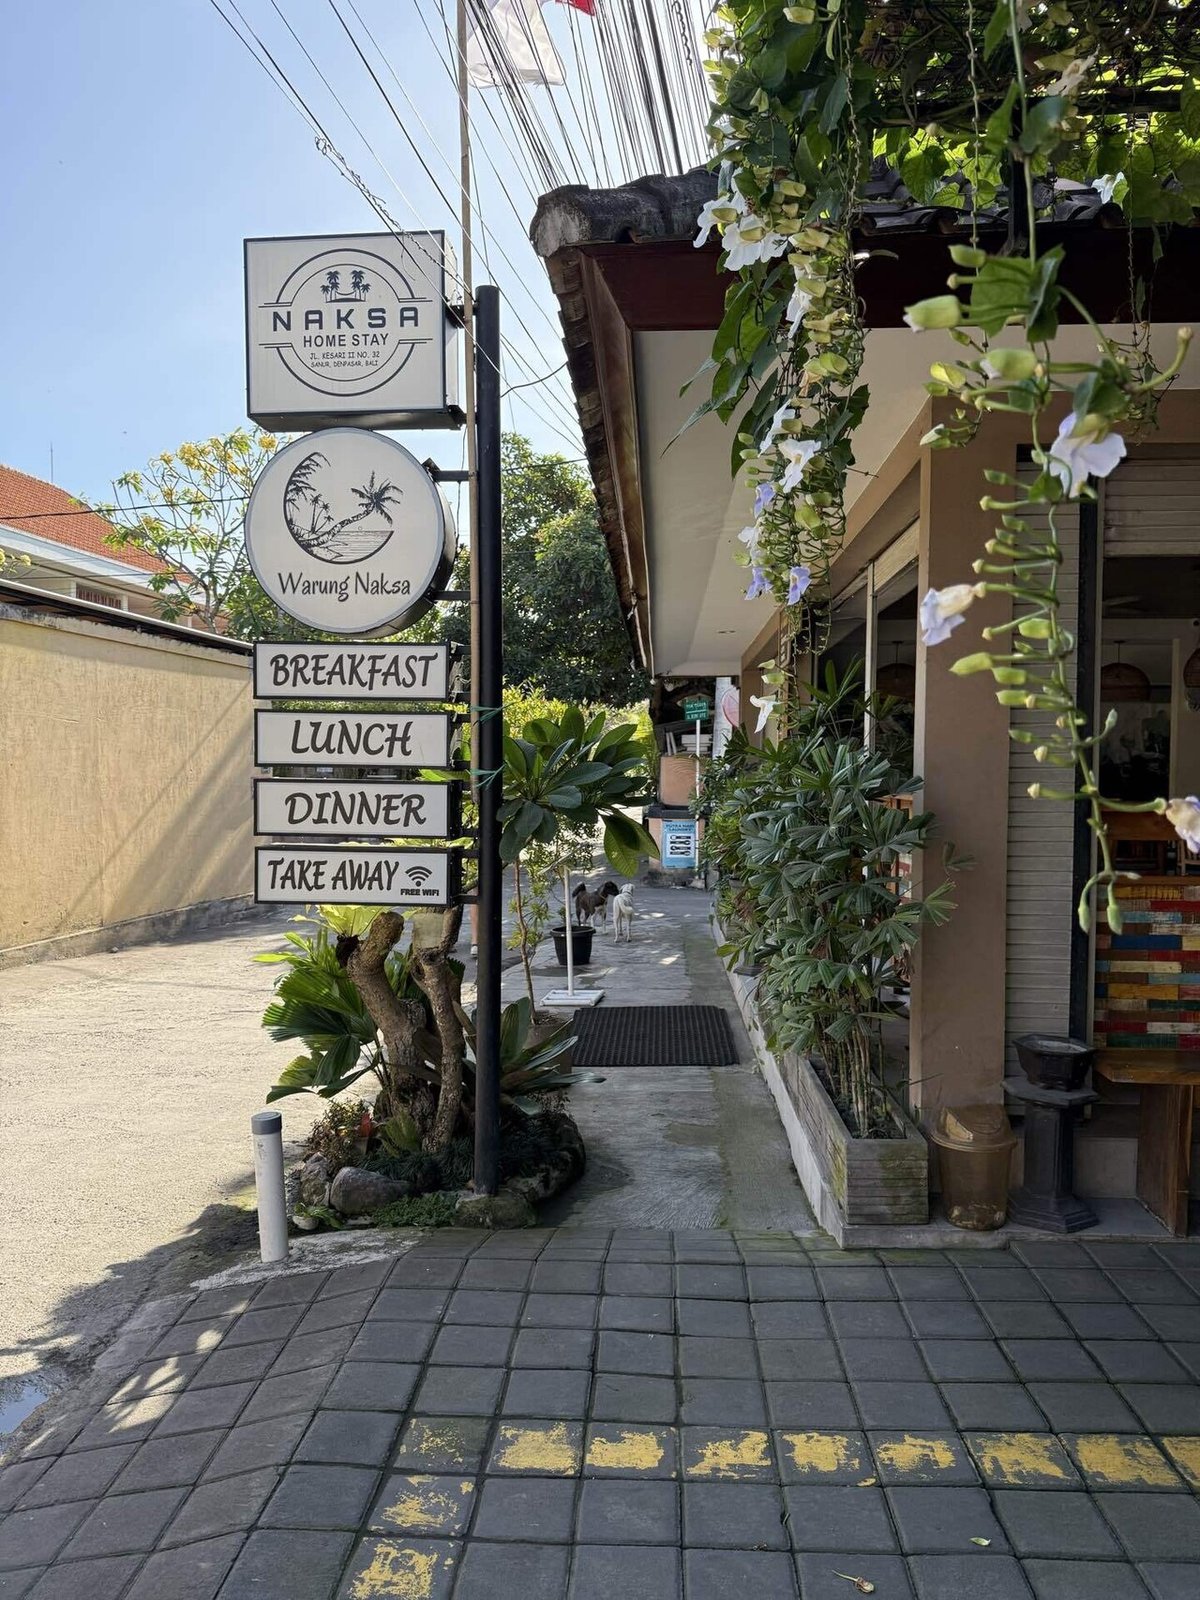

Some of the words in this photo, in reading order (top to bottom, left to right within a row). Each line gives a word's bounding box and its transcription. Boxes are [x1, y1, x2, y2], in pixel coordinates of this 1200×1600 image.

[272, 306, 419, 332] NAKSA
[303, 334, 347, 348] HOME
[351, 333, 389, 347] STAY
[309, 352, 320, 361] JL.
[321, 351, 346, 361] KESARI
[348, 351, 355, 360] II
[357, 351, 371, 360] NO.
[372, 350, 381, 359] 32
[365, 359, 379, 367] BALI
[277, 571, 351, 602] Warung
[354, 571, 411, 595] Naksa
[269, 652, 438, 691] BREAKFAST
[291, 719, 413, 758] LUNCH
[284, 790, 427, 828] DINNER
[267, 857, 327, 892] TAKE
[331, 859, 400, 892] AWAY
[400, 888, 421, 896] FREE
[422, 888, 440, 897] WIFI
